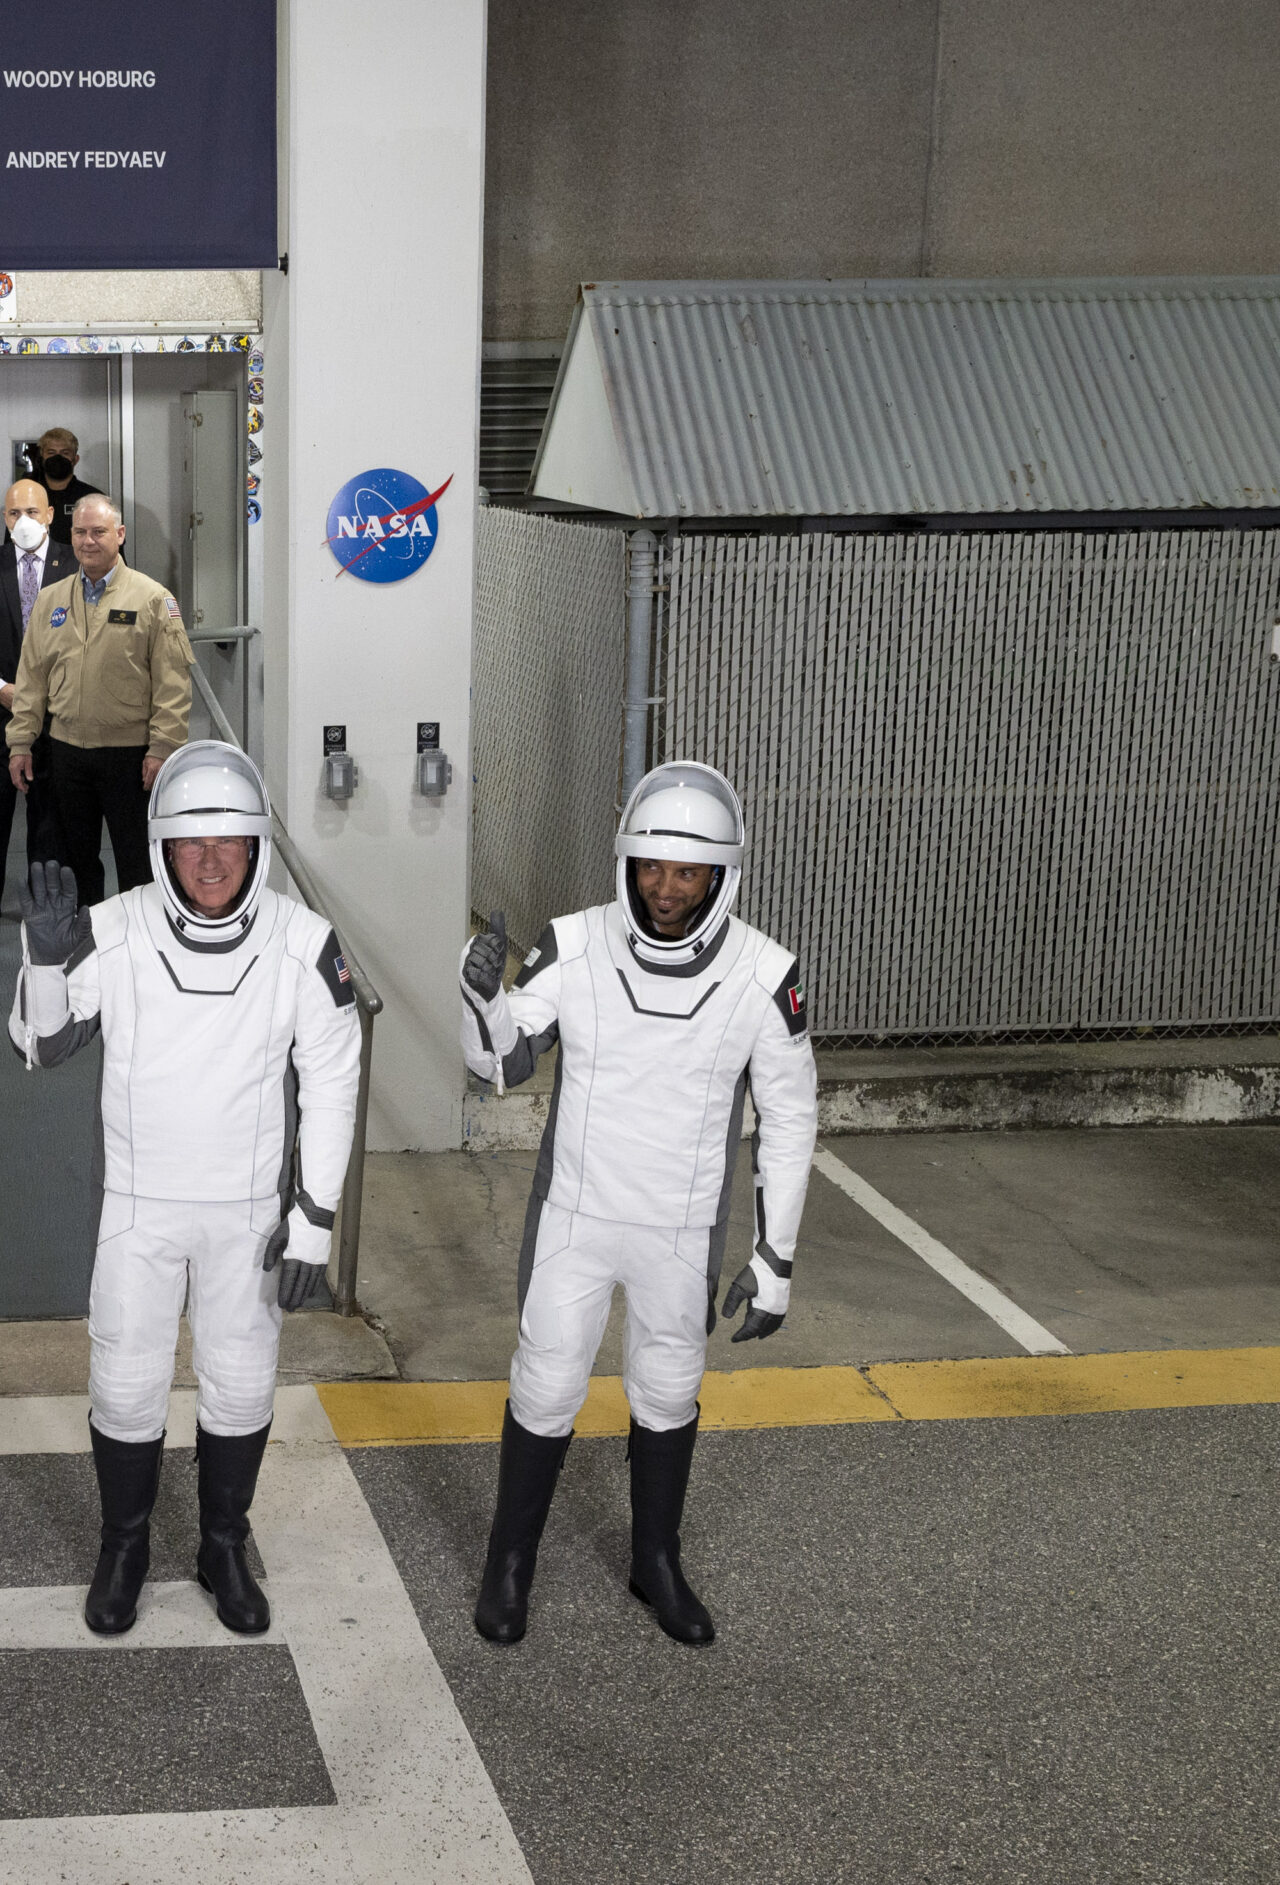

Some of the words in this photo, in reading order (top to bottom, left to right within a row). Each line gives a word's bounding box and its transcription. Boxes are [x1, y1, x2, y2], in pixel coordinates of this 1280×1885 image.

[3, 70, 74, 88] WOODY
[79, 70, 156, 88] HOBURG
[6, 151, 80, 169] ANDREY
[85, 151, 167, 169] FEDYAEV
[336, 514, 433, 539] NASA
